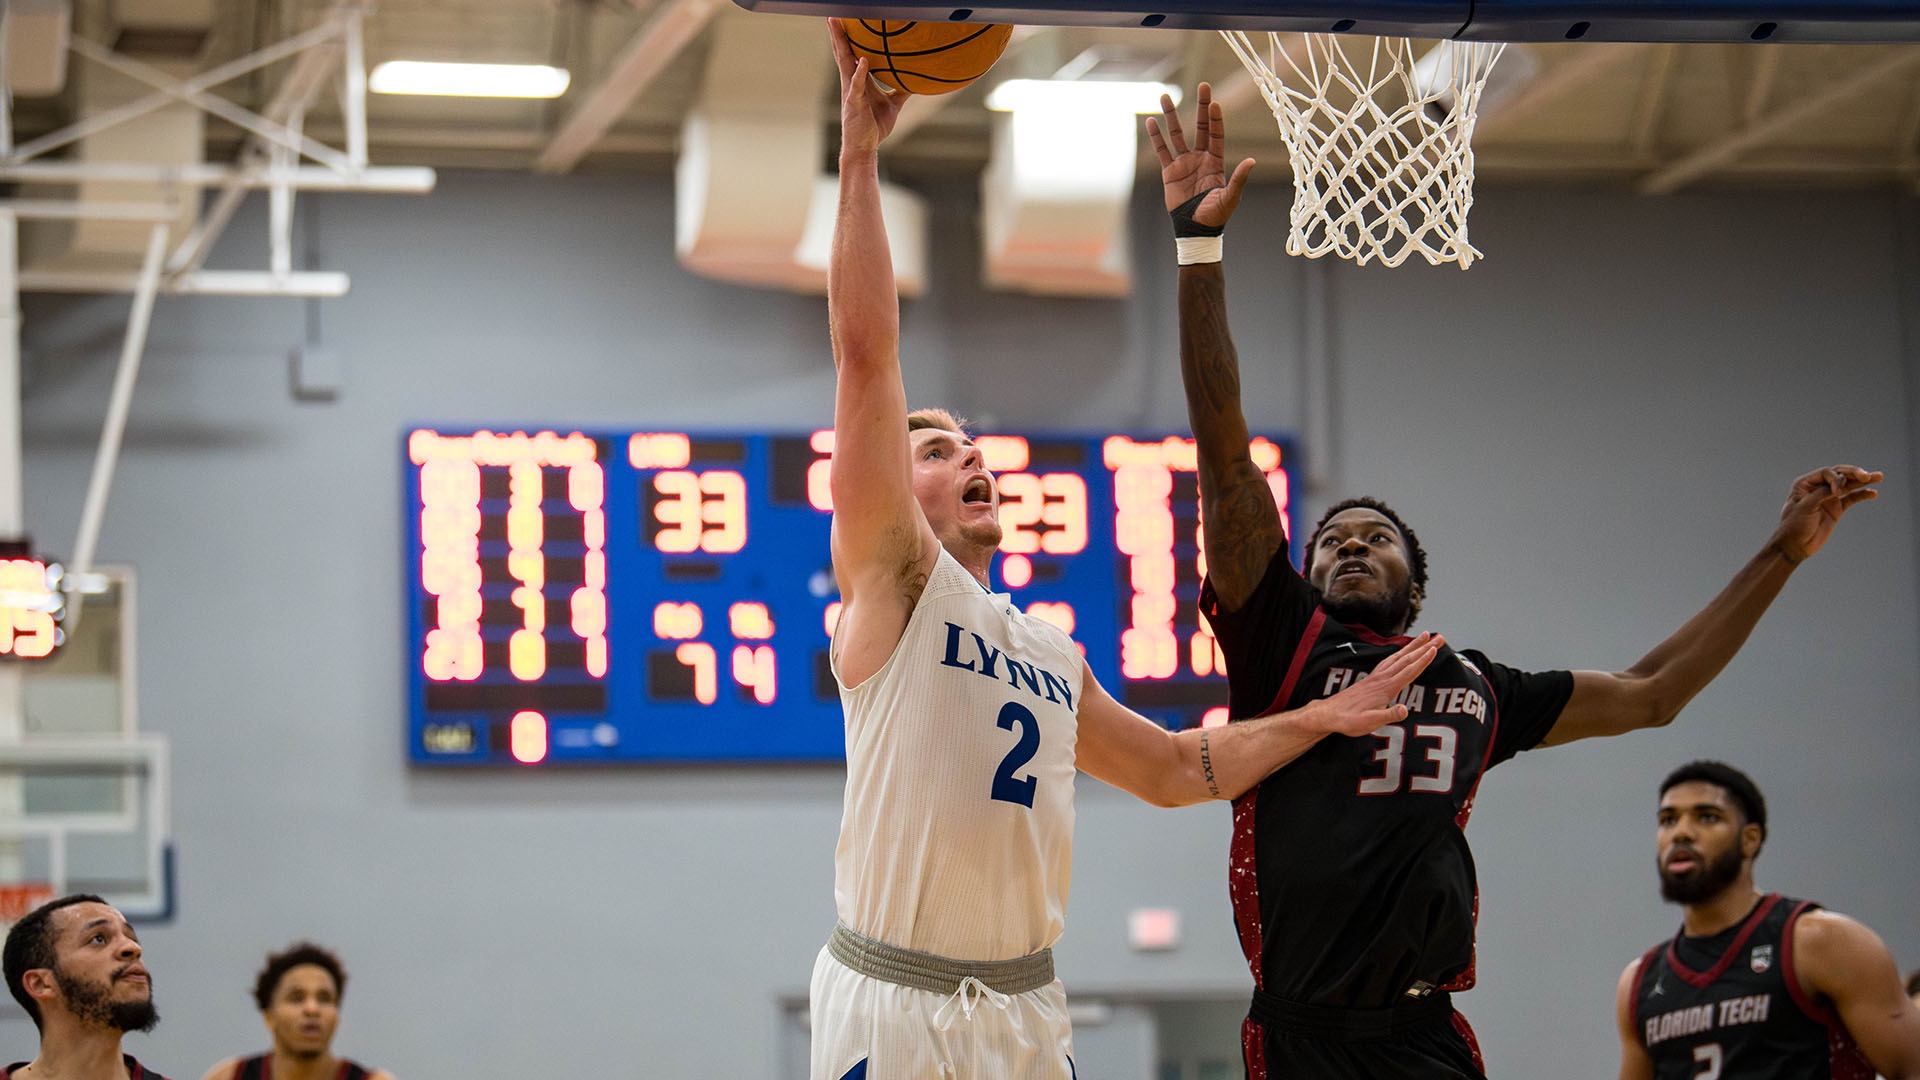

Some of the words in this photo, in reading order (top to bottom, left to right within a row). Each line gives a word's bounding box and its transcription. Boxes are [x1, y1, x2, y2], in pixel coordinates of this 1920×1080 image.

[654, 471, 747, 553] 33
[997, 473, 1089, 554] 23
[676, 642, 718, 705] 7
[732, 645, 777, 704] 4
[941, 621, 1075, 713] LYNN
[1434, 687, 1487, 725] TECH
[991, 701, 1040, 809] 2
[1357, 724, 1458, 796] 33
[1645, 1003, 1714, 1047] FLORIDA
[1718, 994, 1771, 1027] TECH
[1693, 1043, 1723, 1080] 2
